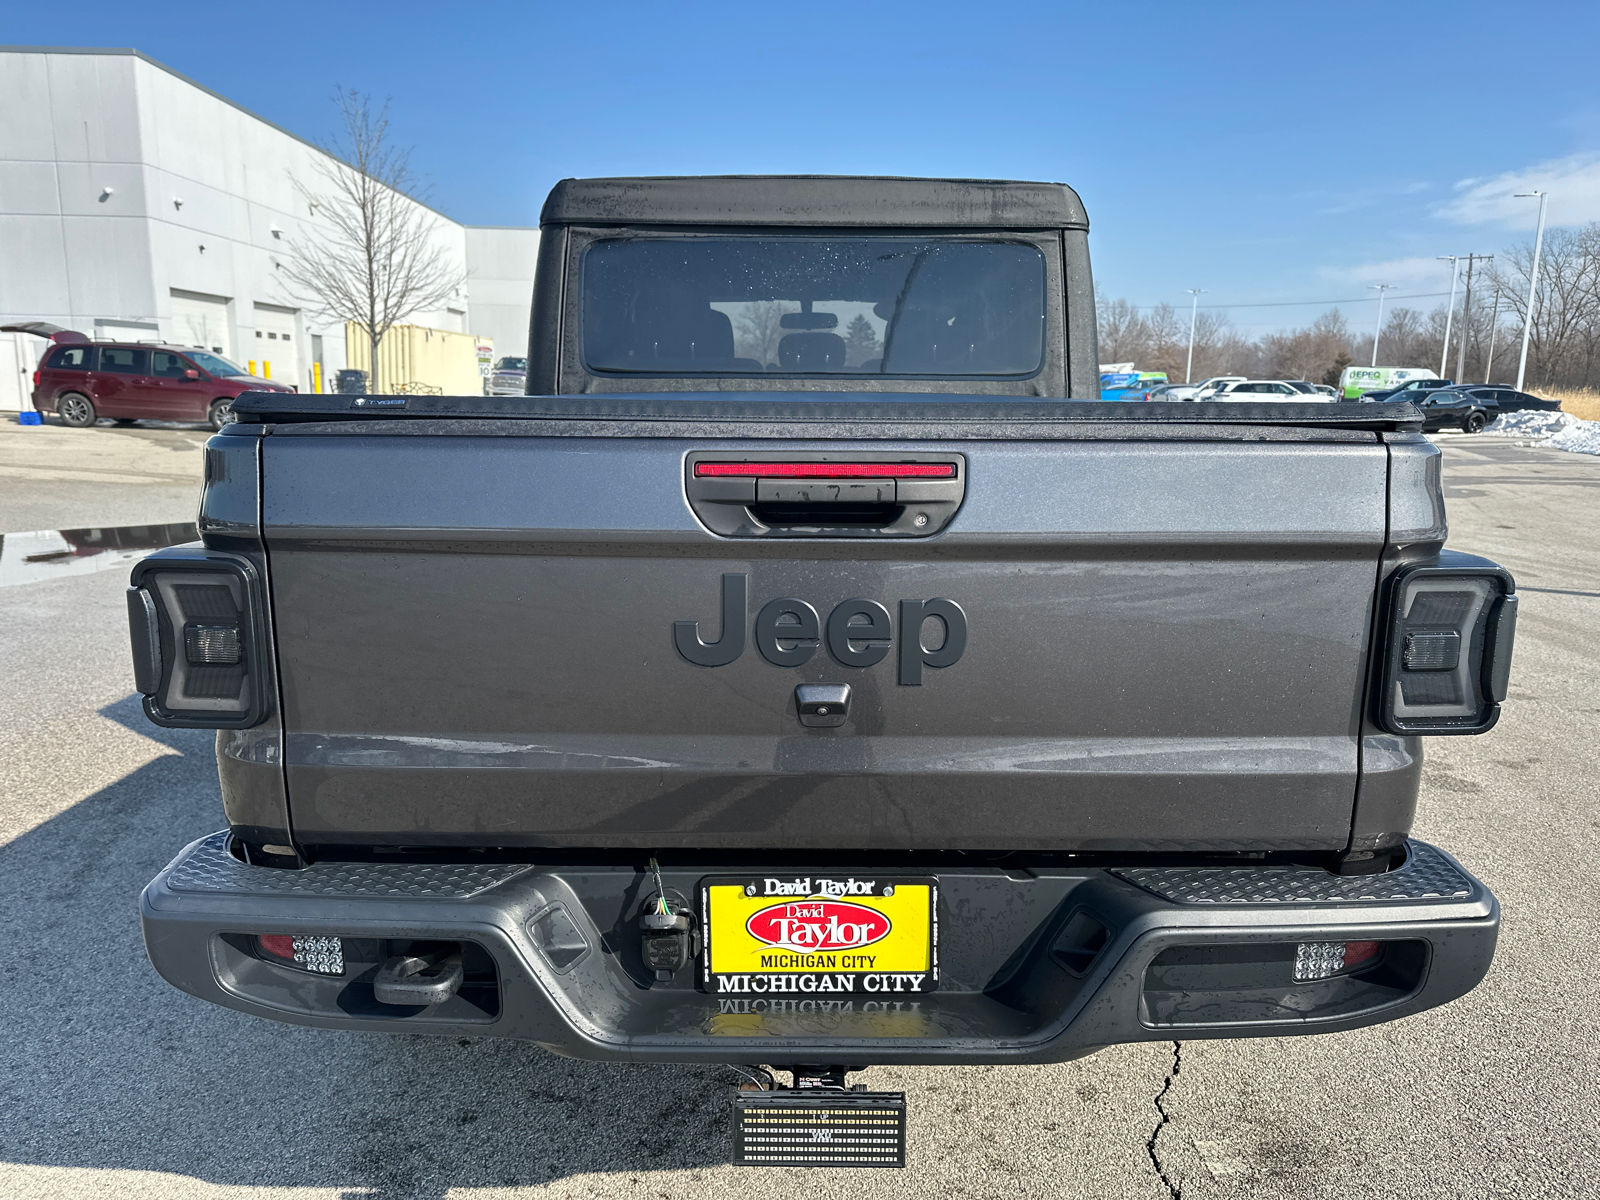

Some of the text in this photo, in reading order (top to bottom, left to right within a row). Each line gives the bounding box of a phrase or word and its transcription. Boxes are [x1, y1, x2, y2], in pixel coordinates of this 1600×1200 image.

[674, 573, 967, 686] Jeep
[764, 878, 875, 900] David Taylor
[785, 904, 824, 918] David
[764, 915, 875, 954] Taylor
[761, 955, 877, 968] MICHIGAN CITY
[717, 974, 926, 993] MICHIGAN CITY
